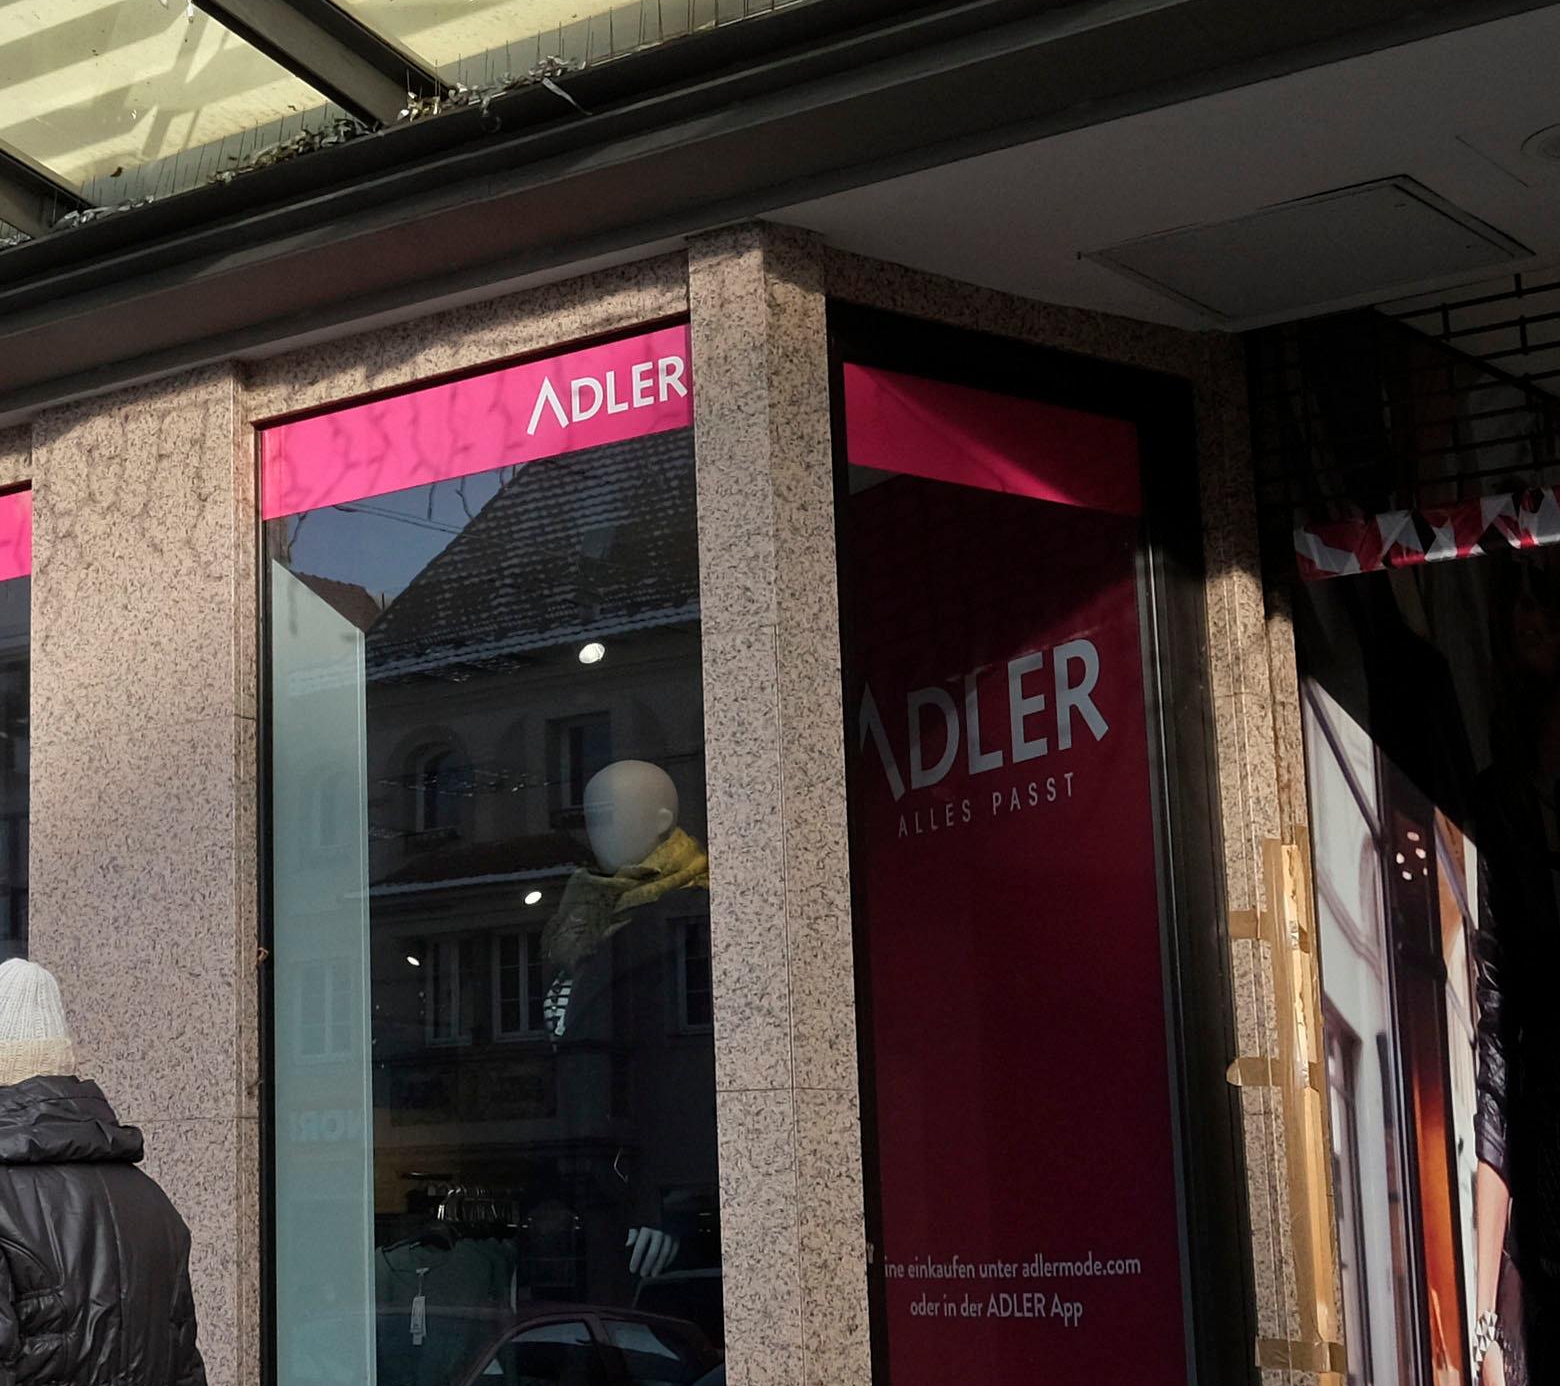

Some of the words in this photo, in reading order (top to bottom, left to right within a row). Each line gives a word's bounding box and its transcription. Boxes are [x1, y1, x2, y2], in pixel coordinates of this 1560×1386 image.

[526, 355, 688, 436] ADLER
[859, 637, 1110, 803] ADLER
[898, 799, 972, 839] ALLES
[991, 771, 1075, 816] PASST
[908, 1254, 975, 1279] einkaufen
[979, 1258, 1017, 1279] unter
[1022, 1251, 1142, 1277] adlermode.com
[910, 1293, 940, 1316] oder
[943, 1294, 957, 1317] in
[960, 1293, 983, 1317] der
[986, 1292, 1047, 1318] ADLER
[1050, 1292, 1083, 1327] App
